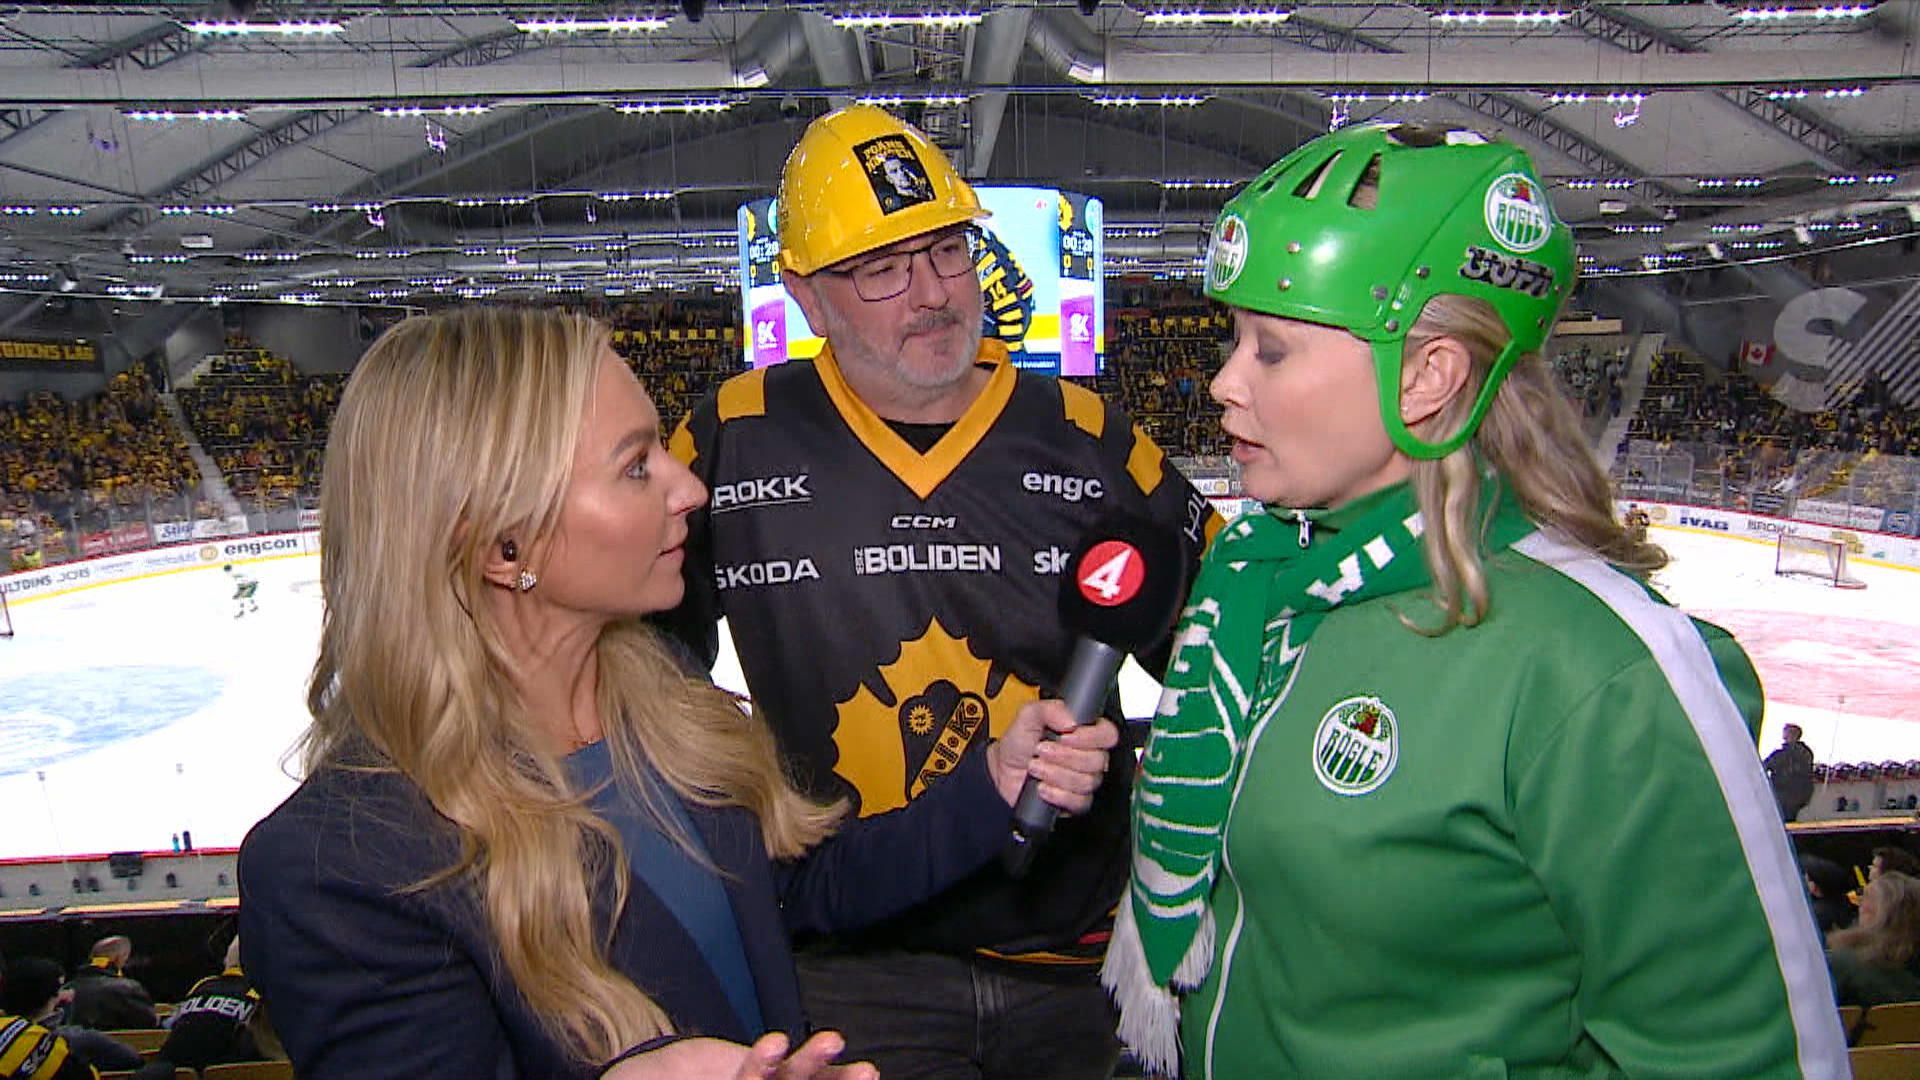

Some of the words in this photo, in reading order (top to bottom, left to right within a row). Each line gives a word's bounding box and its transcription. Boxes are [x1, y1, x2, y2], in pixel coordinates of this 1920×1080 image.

[711, 475, 810, 508] ROKK
[891, 515, 957, 529] CCM
[225, 537, 298, 555] engcon
[864, 544, 1001, 574] BOLIDEN
[1081, 547, 1134, 600] 4
